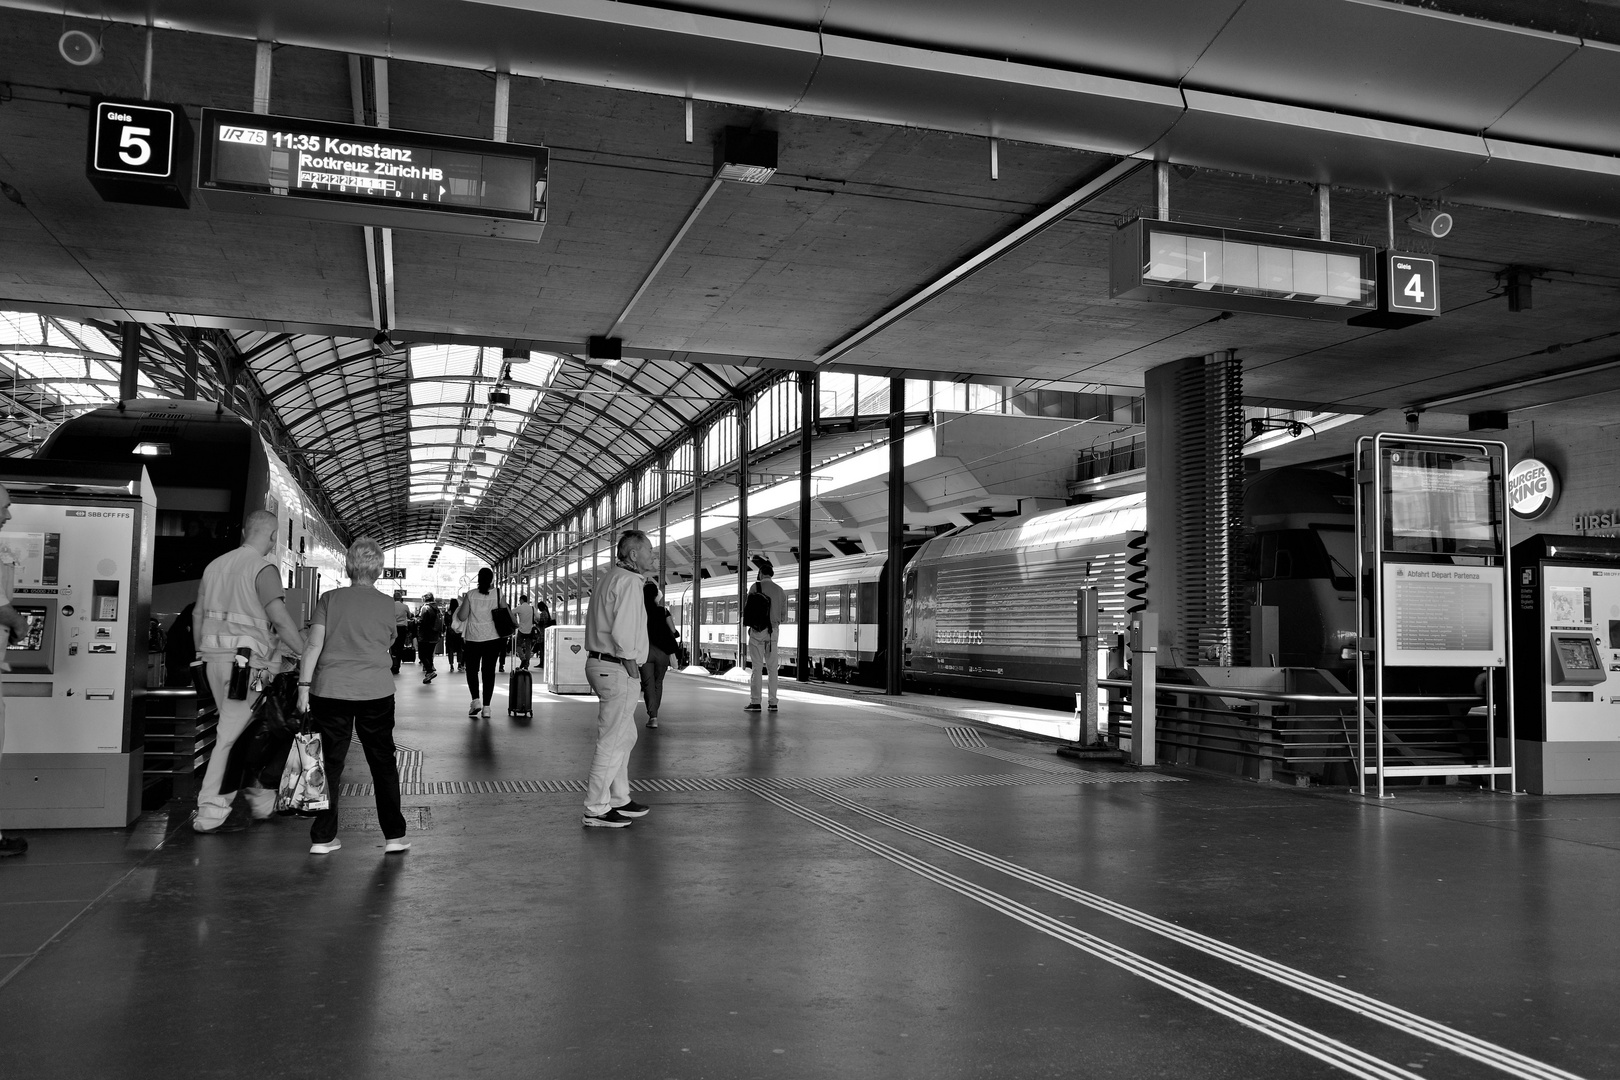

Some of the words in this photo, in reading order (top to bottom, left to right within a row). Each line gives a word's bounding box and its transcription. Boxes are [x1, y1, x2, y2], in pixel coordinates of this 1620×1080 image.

[107, 112, 132, 122] Gleis
[119, 125, 151, 166] 5
[247, 130, 264, 143] 75
[272, 132, 320, 151] 11:35
[325, 137, 412, 162] Konstanz
[301, 154, 369, 173] Rotkreuz
[374, 161, 420, 179] Zürich
[422, 167, 443, 181] HB
[1404, 273, 1425, 303] 4
[1508, 467, 1545, 491] BURGER
[1509, 477, 1547, 507] KING
[1408, 570, 1430, 578] Abfahrt
[1454, 572, 1480, 580] Partenza
